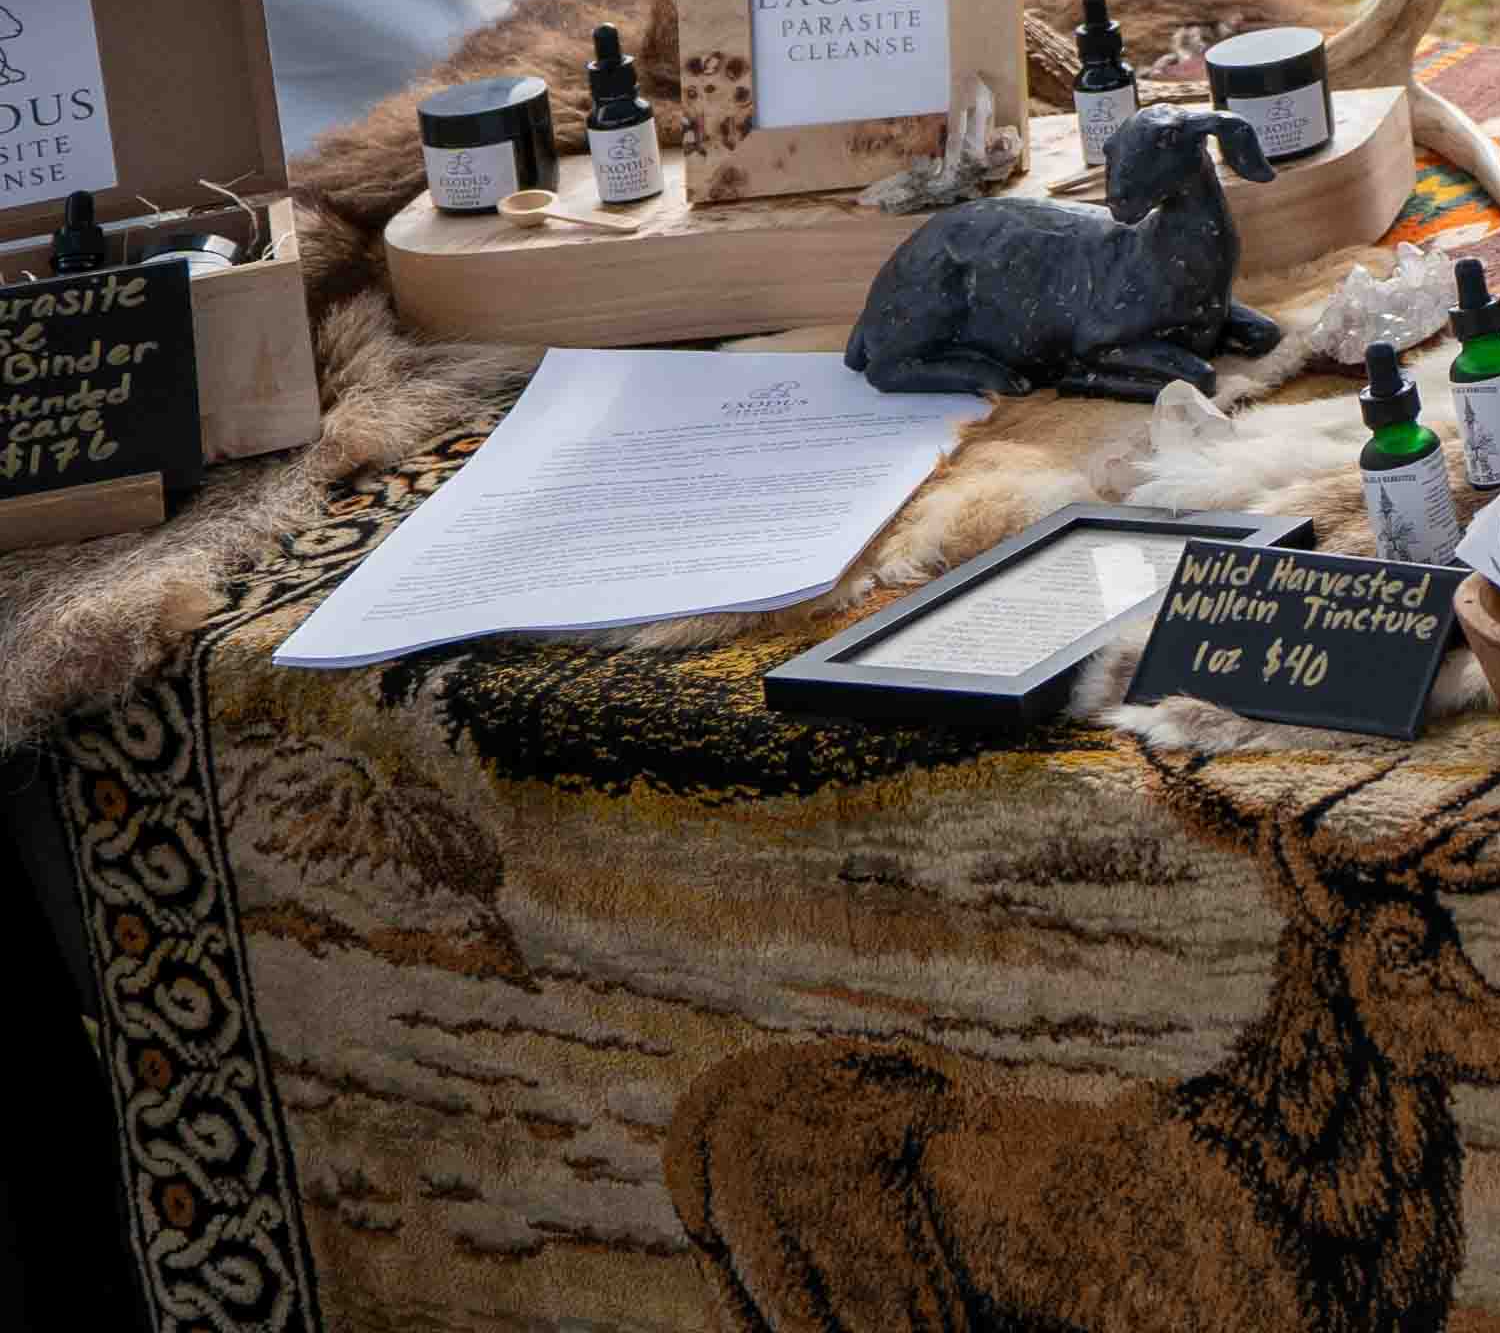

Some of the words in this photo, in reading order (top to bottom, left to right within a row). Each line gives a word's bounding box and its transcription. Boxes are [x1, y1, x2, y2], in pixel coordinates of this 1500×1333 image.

[782, 9, 921, 37] PARASITE
[788, 36, 916, 62] CLEANSE
[3, 339, 160, 383] Binder
[8, 408, 104, 442] care
[1179, 551, 1256, 588] Wild
[1270, 556, 1433, 610] Harvested
[1166, 590, 1281, 624] Mullein
[1302, 594, 1440, 641] Tincture
[1263, 636, 1329, 687] $40
